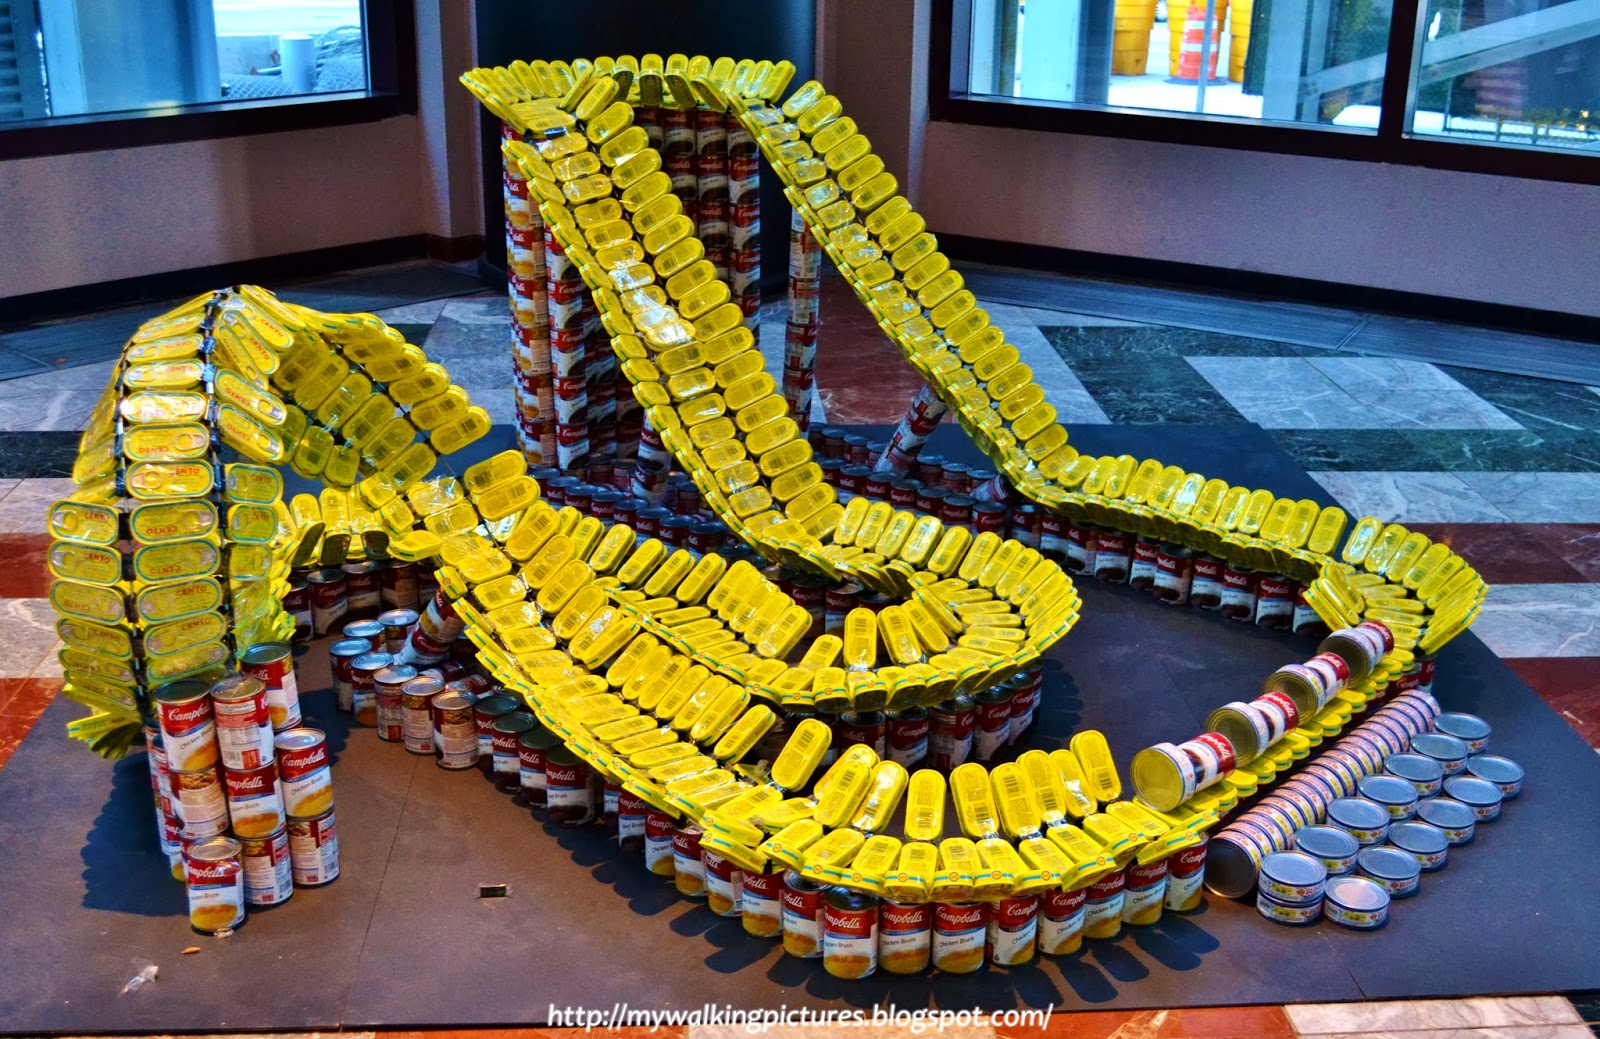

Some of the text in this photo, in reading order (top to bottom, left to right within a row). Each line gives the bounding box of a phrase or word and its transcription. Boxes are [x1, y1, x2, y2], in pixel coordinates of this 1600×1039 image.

[260, 318, 284, 338] CENTO
[250, 337, 270, 360] CENTO
[138, 446, 169, 454] CENTO
[251, 474, 272, 484] CENTO
[146, 525, 178, 535] CENTO
[83, 553, 111, 564] CENTO
[149, 564, 181, 575] CENTO
[176, 585, 207, 597] CENTO
[291, 782, 311, 796] Chicken
[1133, 893, 1152, 904] Chicken
[1087, 906, 1108, 917] Chicken
[939, 940, 959, 948] Chicken
